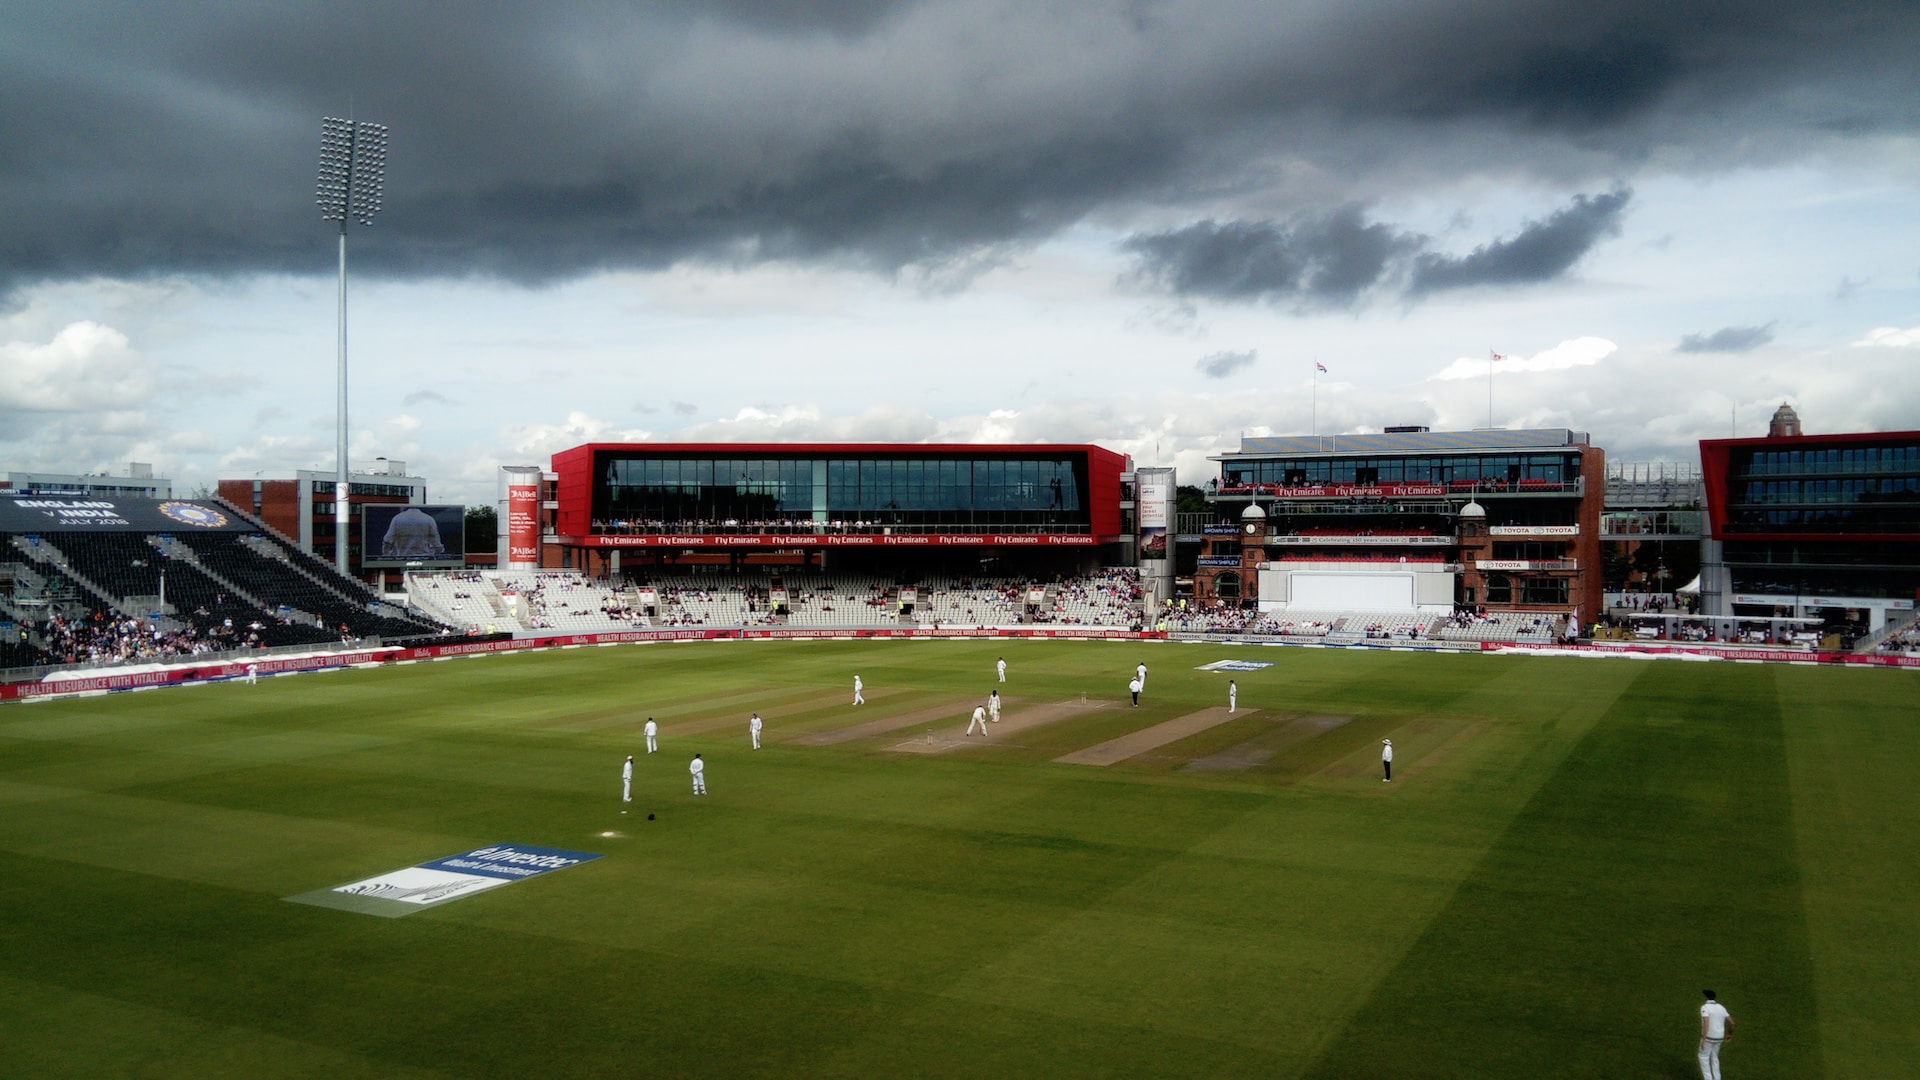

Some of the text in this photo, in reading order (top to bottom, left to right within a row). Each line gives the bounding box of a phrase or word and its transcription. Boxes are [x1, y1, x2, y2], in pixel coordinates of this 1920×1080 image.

[1279, 487, 1325, 496] Fly Emirates
[1335, 487, 1382, 496] Fly Emirates
[1393, 486, 1441, 496] Fly Emirates
[14, 500, 115, 509] ENGLAND
[60, 509, 119, 518] INDIA
[600, 536, 647, 545] Fly Emirates
[658, 536, 704, 545] Fly Emirates
[715, 536, 760, 545] Fly Emirates
[772, 536, 817, 545] Fly Emirates
[828, 536, 873, 545] Fly Emirates
[884, 536, 928, 545] Fly Emirates
[939, 536, 983, 545] Fly Emirates
[994, 536, 1038, 545] Fly Emirates
[1049, 536, 1092, 545] Fly Emirates
[597, 630, 706, 642] HEALTH INSURANCE WITH VITALITY
[440, 639, 535, 656] HEALTH INSURANCE WITH VITALITY
[1448, 641, 1478, 649] Investec
[1727, 650, 1767, 659] INSURANCE
[1768, 652, 1787, 660] WITH
[1788, 652, 1819, 661] VITALITY
[256, 653, 373, 673] HEALTH INSURANCE WITH VITALITY
[17, 671, 169, 697] HEALTH INSURANCE WITH VITALITY
